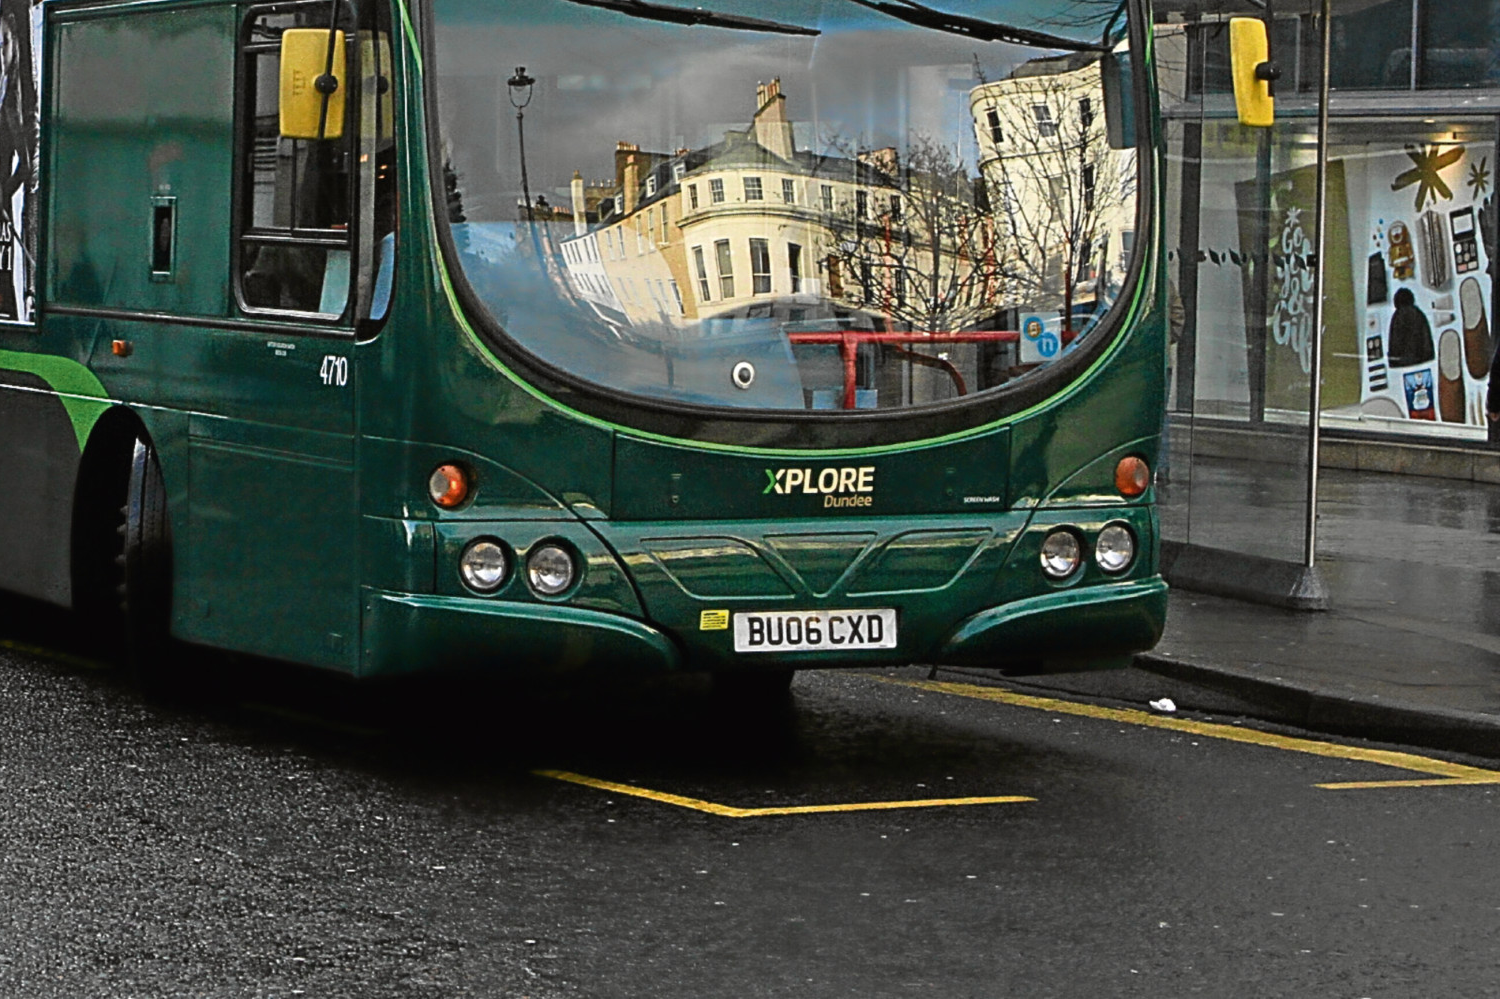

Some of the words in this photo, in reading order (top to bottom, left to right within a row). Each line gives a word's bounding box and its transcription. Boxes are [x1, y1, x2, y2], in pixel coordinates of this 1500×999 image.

[7, 245, 12, 271] 1
[319, 355, 348, 386] 4710
[762, 465, 876, 495] XPLORE
[822, 494, 873, 508] Dundee
[747, 615, 823, 647] BU06
[827, 613, 884, 645] CXD
